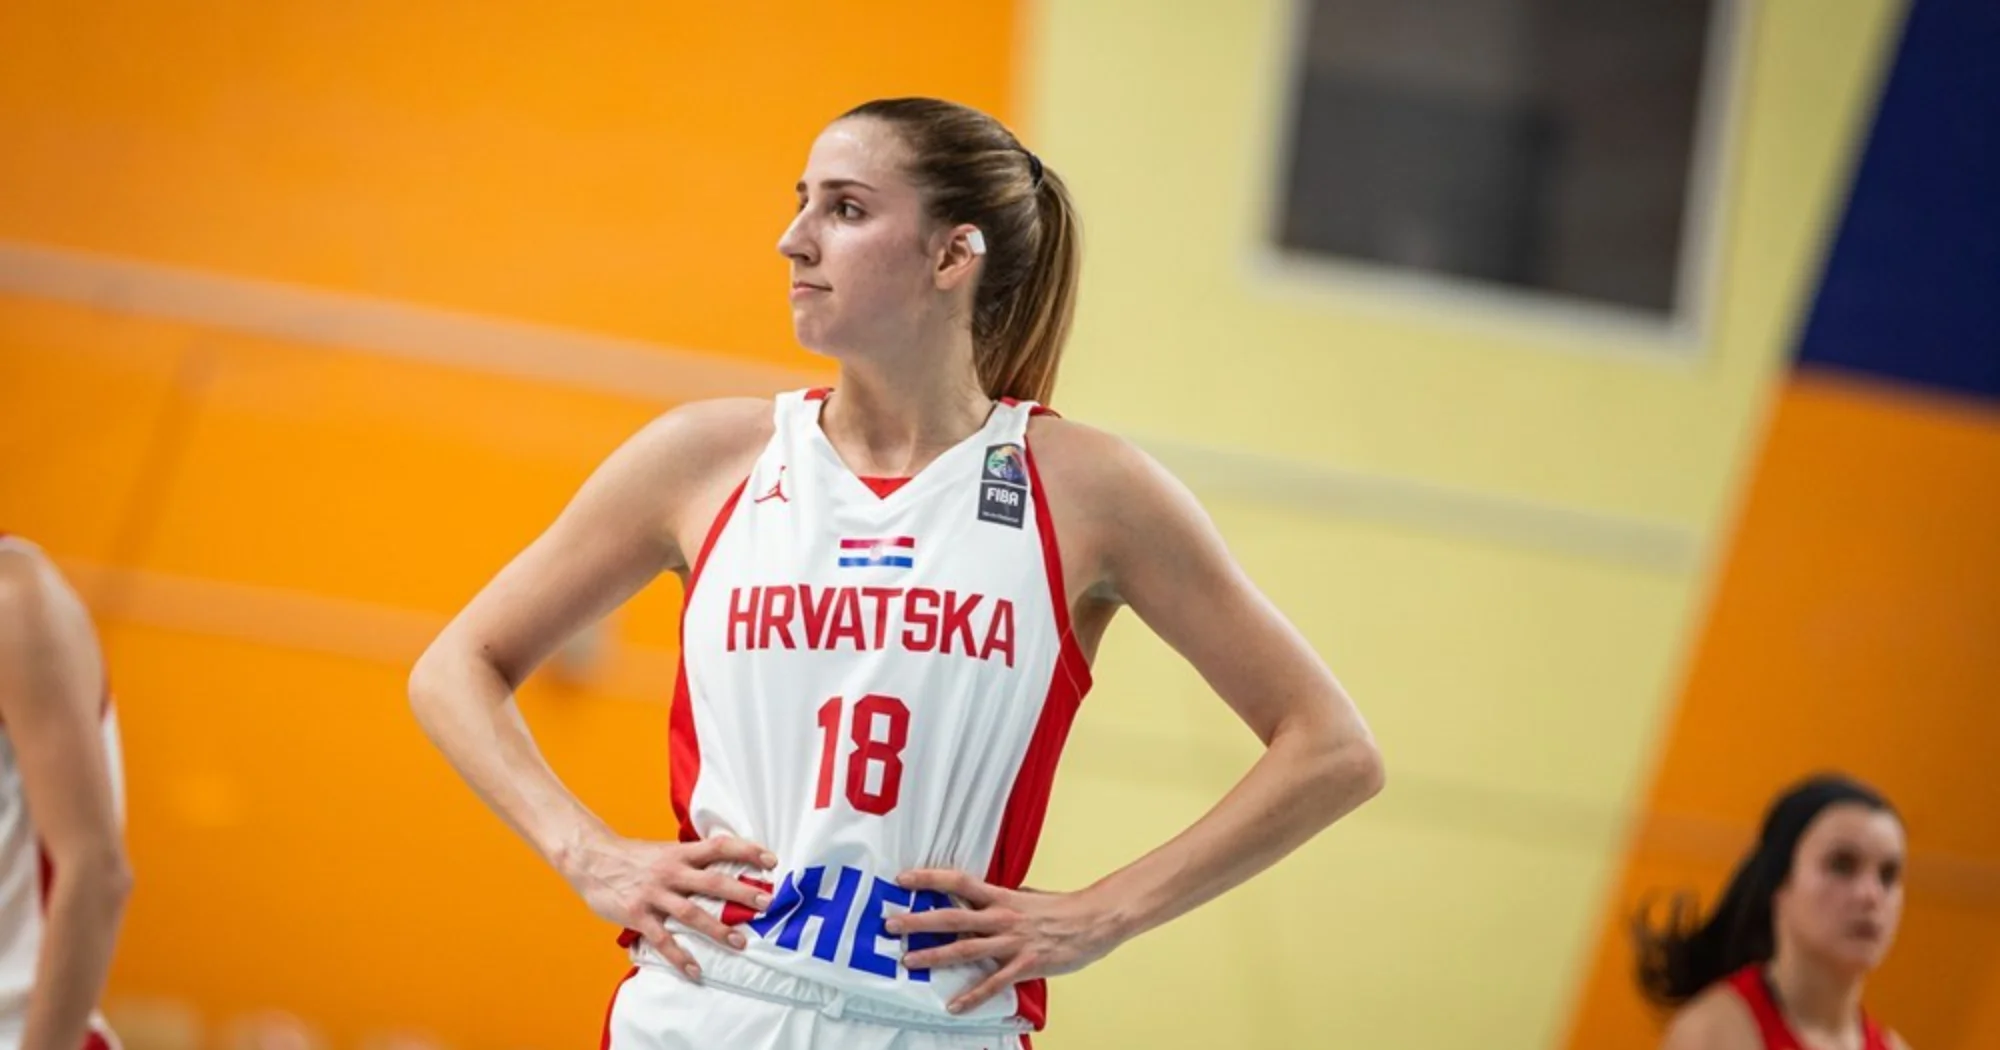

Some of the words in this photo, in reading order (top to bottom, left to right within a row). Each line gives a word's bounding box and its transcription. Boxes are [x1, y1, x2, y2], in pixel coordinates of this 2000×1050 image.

[985, 487, 1020, 507] FIBA
[726, 583, 1015, 669] HRVATSKA
[814, 693, 911, 817] 18
